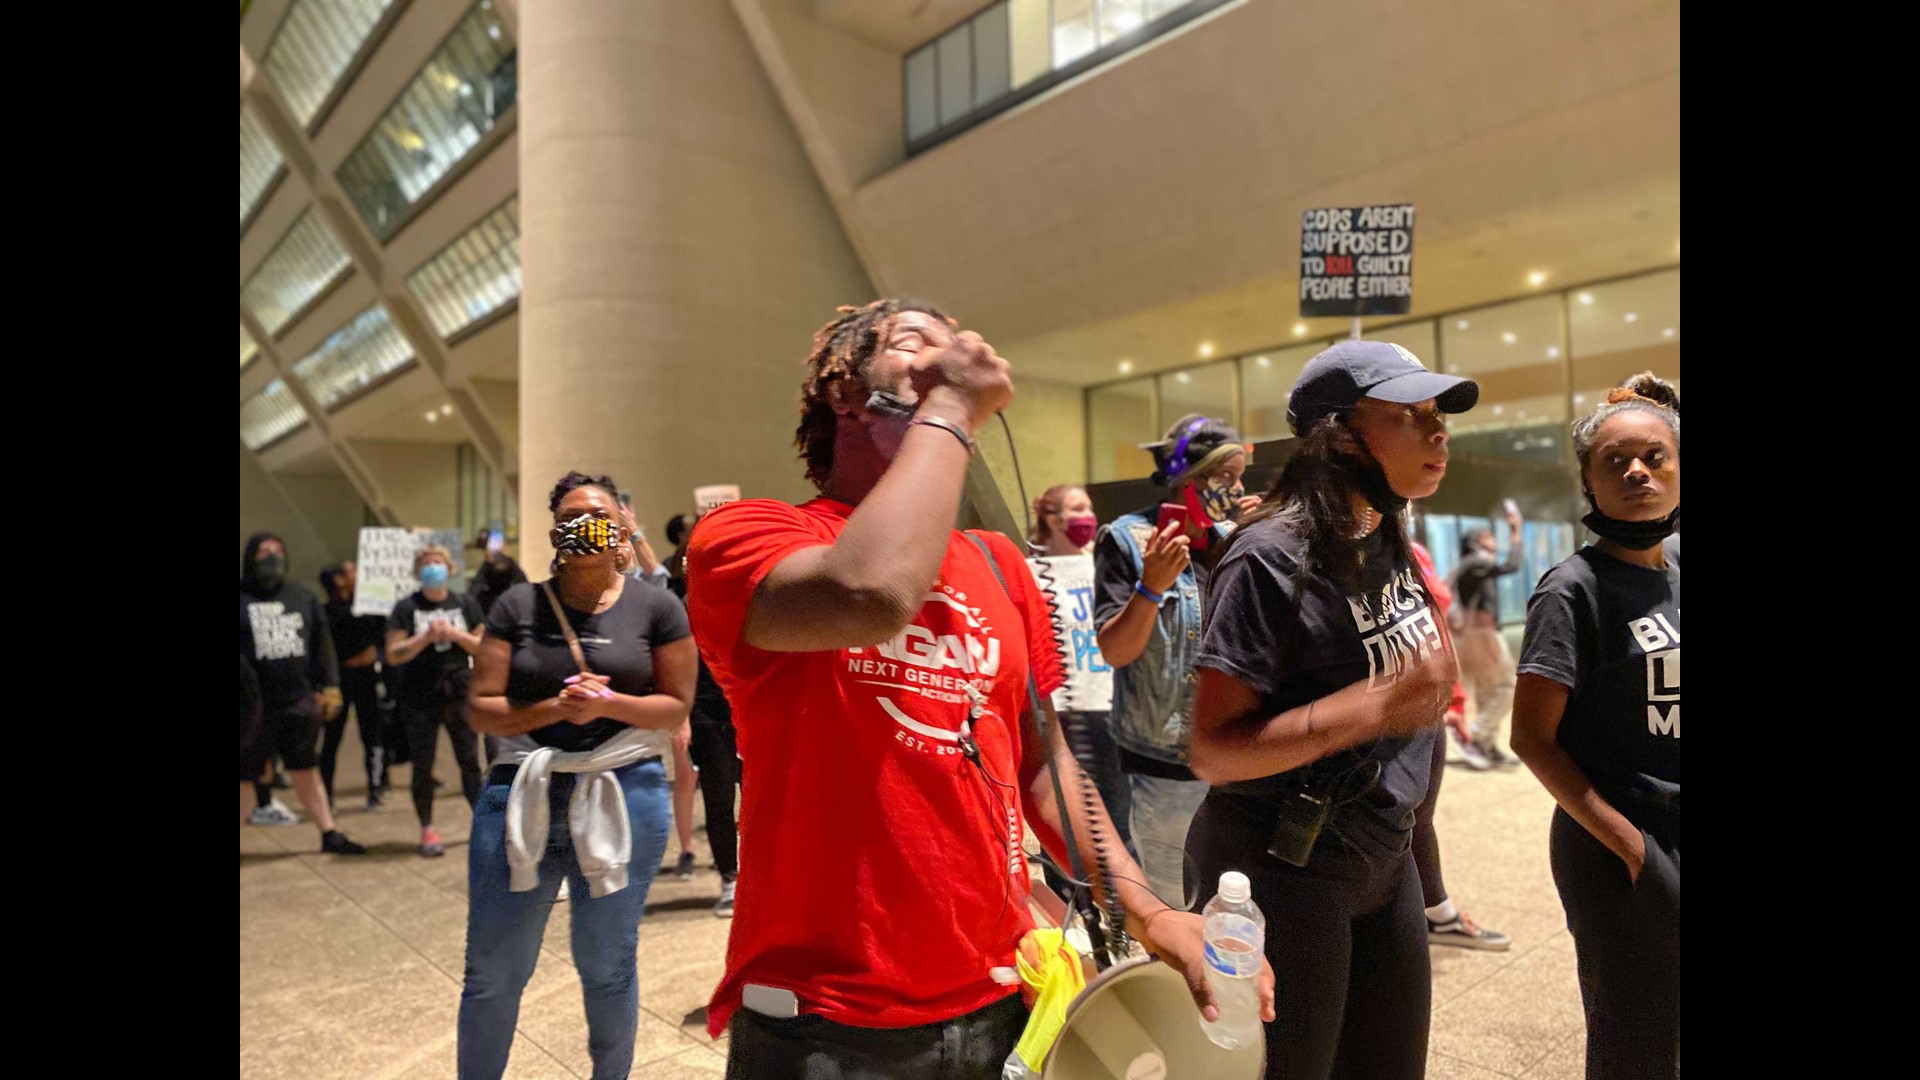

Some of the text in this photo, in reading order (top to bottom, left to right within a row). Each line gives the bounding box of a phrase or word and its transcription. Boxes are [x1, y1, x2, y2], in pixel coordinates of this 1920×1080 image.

[1303, 209, 1352, 231] COPS
[1302, 230, 1409, 255] SUPPOSED
[1301, 254, 1411, 275] TO KILL GUILTY
[1301, 276, 1354, 300] PEOPLE
[1627, 609, 1680, 652] BL
[1072, 630, 1111, 673] PE
[848, 658, 898, 678] NEXT
[895, 730, 929, 753] EST.
